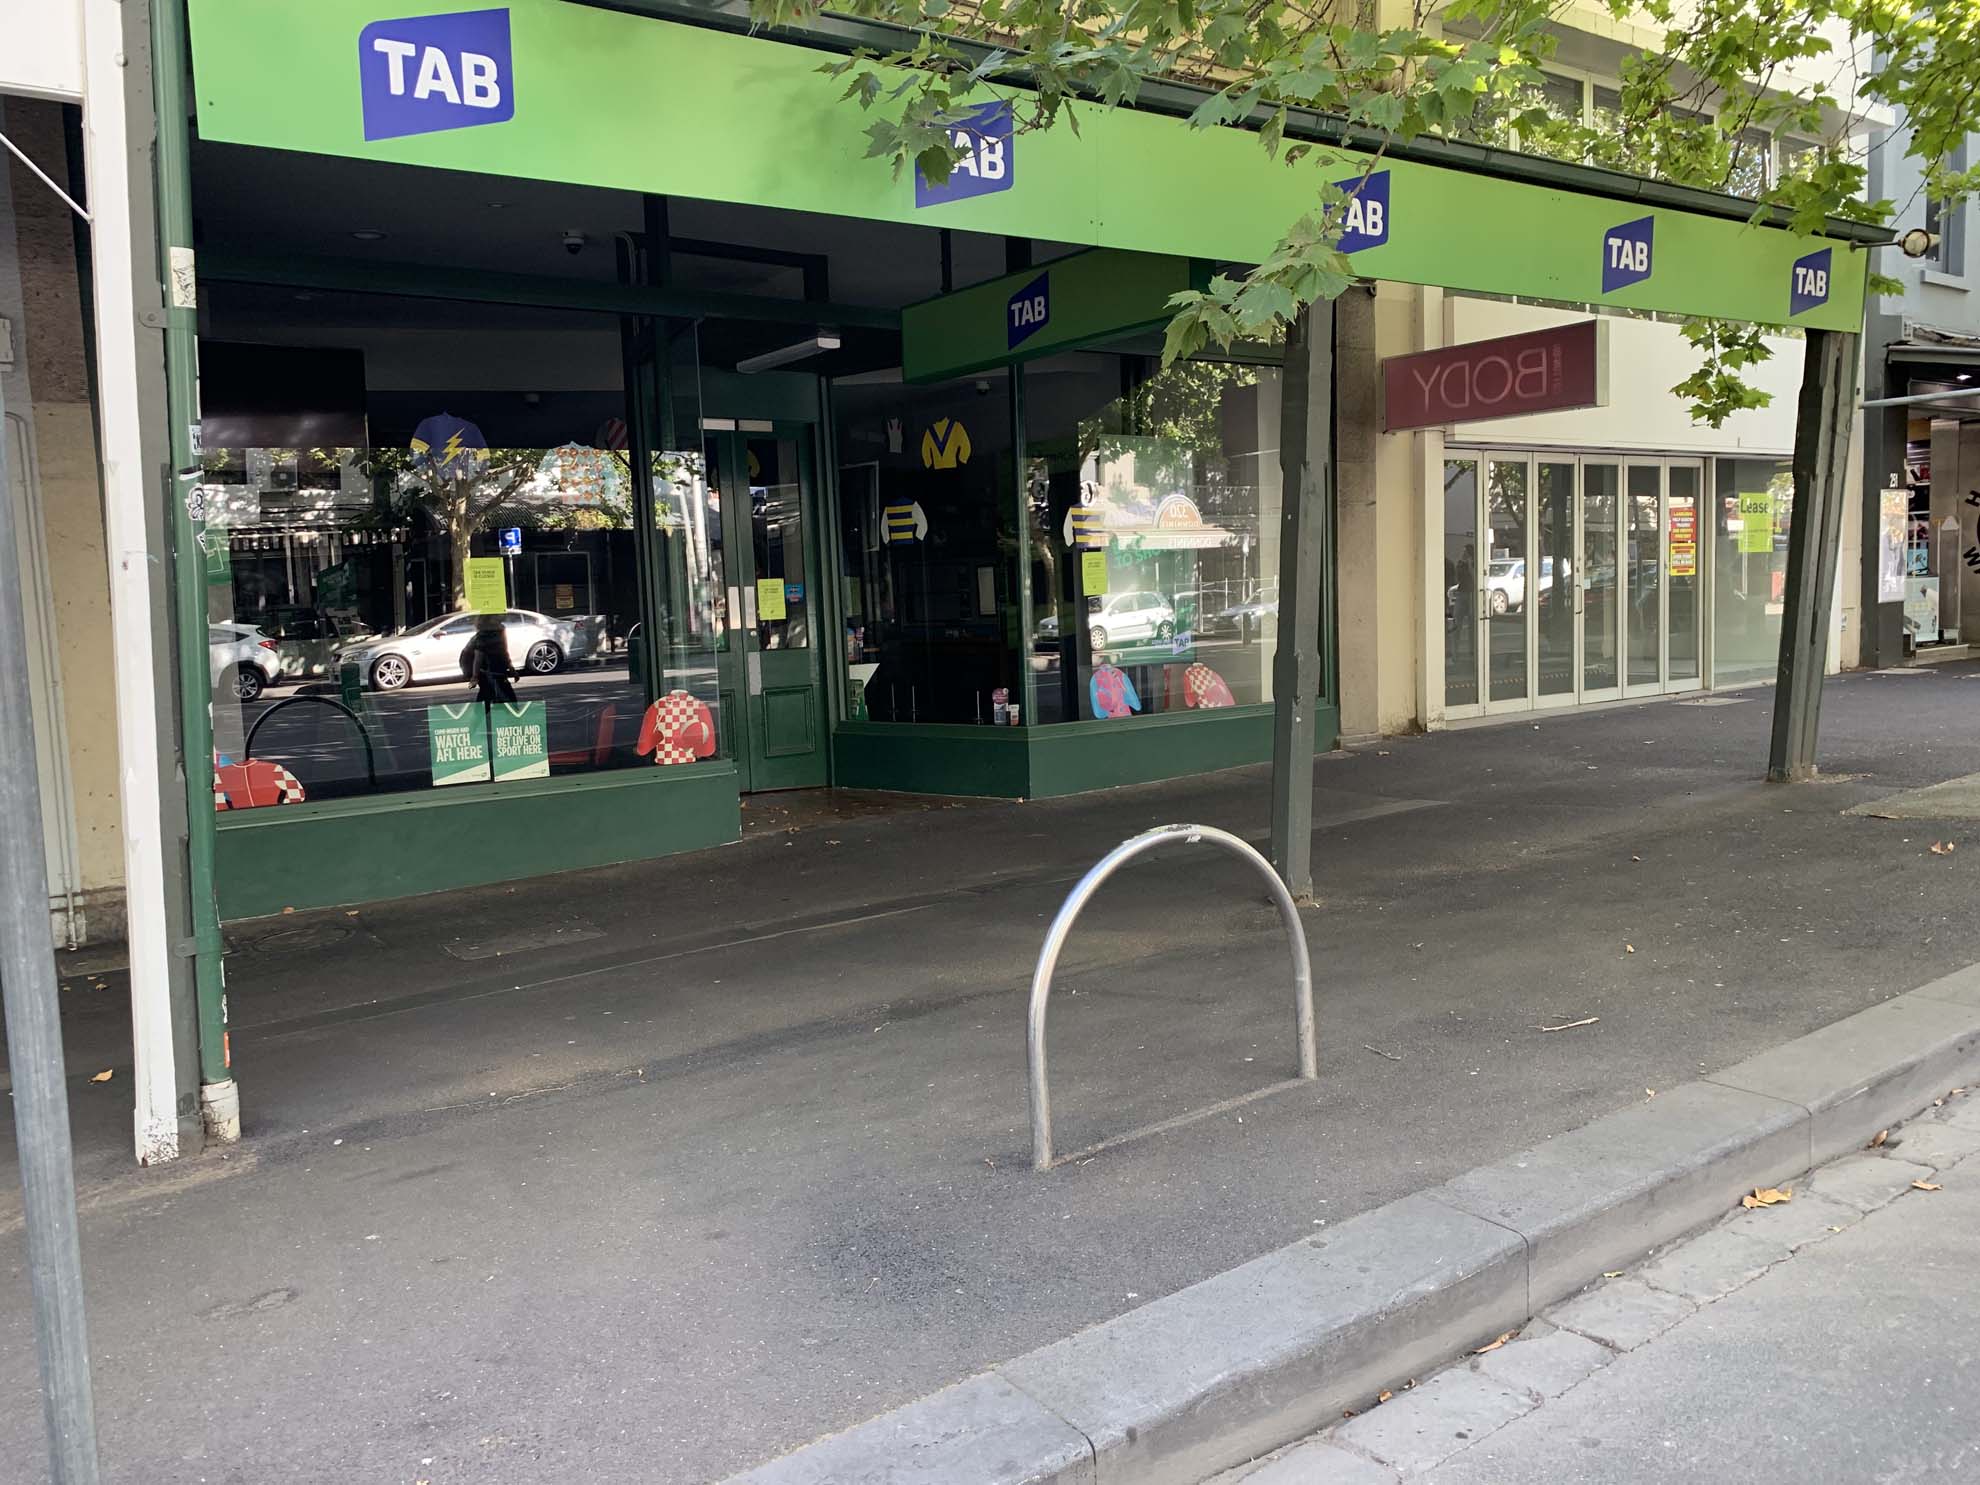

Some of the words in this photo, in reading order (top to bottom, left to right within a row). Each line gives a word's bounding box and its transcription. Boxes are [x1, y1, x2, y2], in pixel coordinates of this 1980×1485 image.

[373, 38, 501, 109] TAB
[945, 129, 1006, 180] AB
[1336, 197, 1384, 237] AB
[1608, 238, 1649, 273] TAB
[1795, 265, 1827, 298] TAB
[1011, 295, 1046, 327] TAB
[1740, 499, 1769, 514] Lease
[435, 733, 471, 748] WATCH
[496, 726, 522, 737] WATCH
[523, 725, 540, 735] AND
[497, 736, 513, 747] BET
[514, 735, 528, 746] LIVE
[529, 734, 541, 745] ON
[436, 748, 455, 763] AFL
[457, 745, 484, 761] HERE
[497, 746, 521, 757] SPORT
[523, 744, 542, 755] HERE
